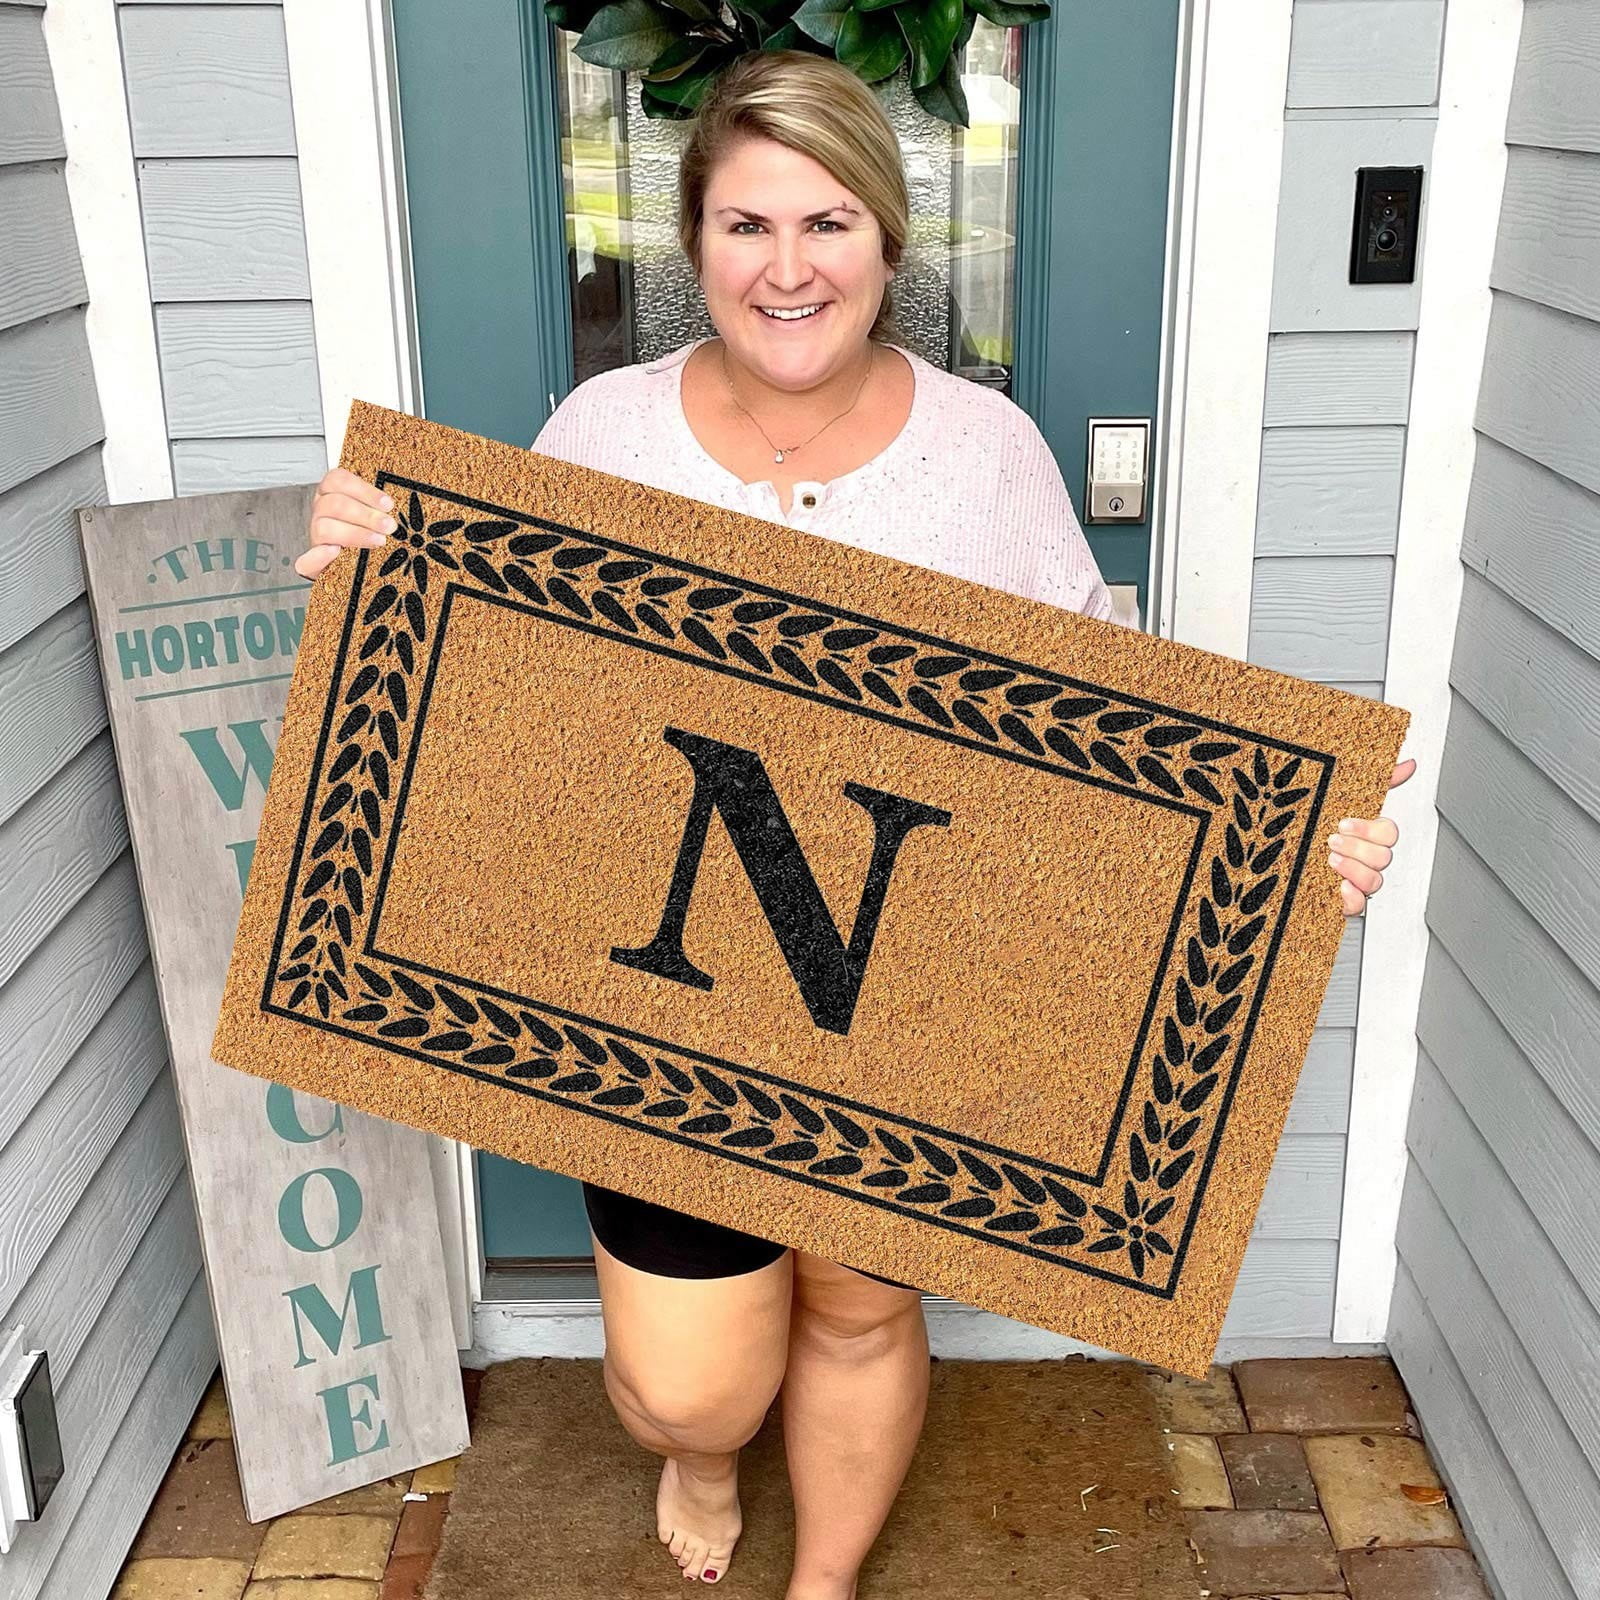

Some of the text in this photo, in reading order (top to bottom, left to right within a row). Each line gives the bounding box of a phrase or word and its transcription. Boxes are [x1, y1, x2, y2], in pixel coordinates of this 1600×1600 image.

[152, 537, 275, 584] THE
[609, 725, 953, 1036] N
[179, 716, 392, 1467] WCOME
